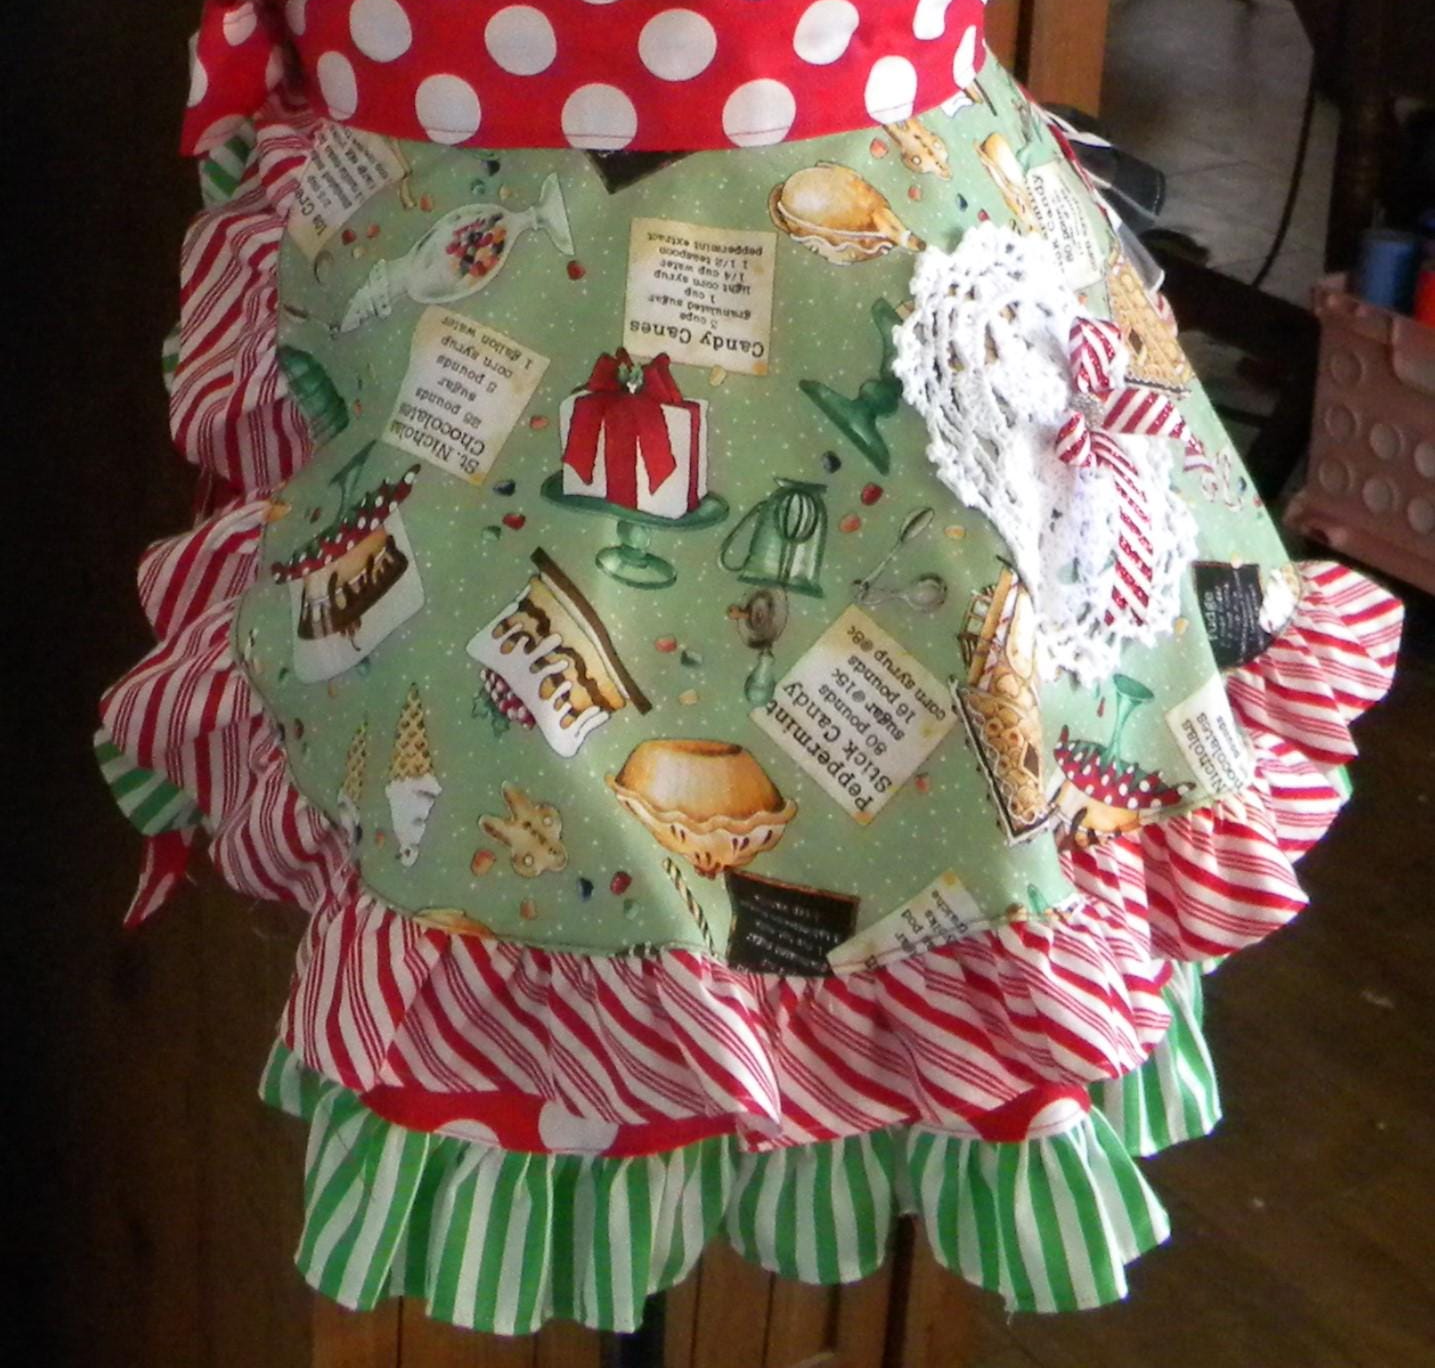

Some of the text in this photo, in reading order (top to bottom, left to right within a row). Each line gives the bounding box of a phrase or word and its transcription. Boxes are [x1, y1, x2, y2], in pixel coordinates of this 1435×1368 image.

[647, 232, 764, 257] peppermint extract
[659, 247, 712, 265] teaspoon
[653, 270, 689, 284] syrup
[660, 259, 745, 281] 1/4 cup water
[684, 287, 705, 300] cup
[692, 278, 720, 290] corn
[648, 294, 752, 321] granulated sugar
[679, 312, 708, 324] cups
[441, 316, 476, 337] water
[629, 319, 765, 358] Candy Canes
[441, 335, 513, 378] corn syrup
[481, 335, 522, 361] gallon
[436, 354, 486, 384] pounds
[415, 387, 461, 415] pounds
[437, 378, 476, 401] sugar
[457, 452, 480, 475] St.
[848, 656, 901, 704] pounds
[874, 650, 916, 690] syrup
[914, 688, 946, 720] corn
[818, 684, 887, 756] 80 pounds
[865, 703, 905, 740] sugar
[783, 682, 893, 793] Stick Candy
[763, 695, 874, 812] Peppermint
[1182, 719, 1226, 794] Nicholas
[1196, 712, 1243, 792] hocolates
[901, 909, 924, 934] pod
